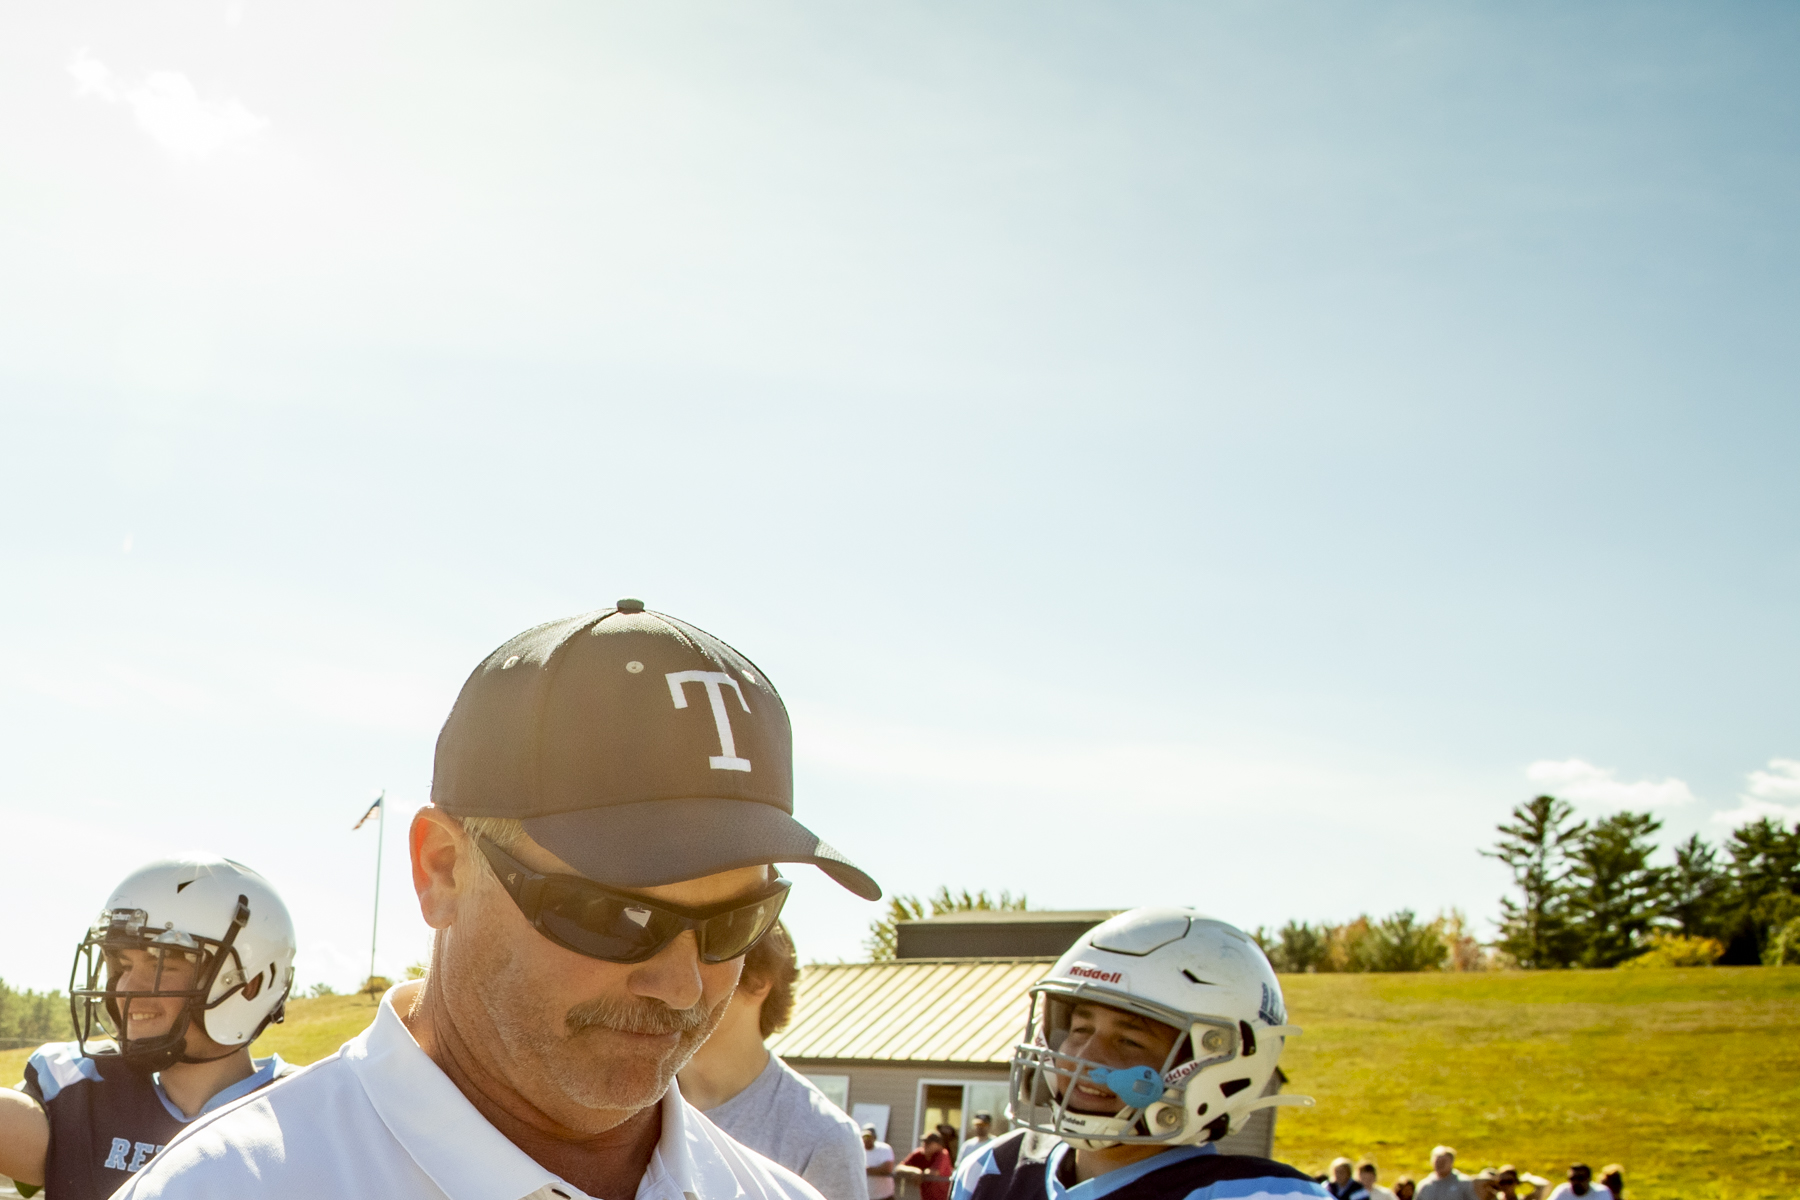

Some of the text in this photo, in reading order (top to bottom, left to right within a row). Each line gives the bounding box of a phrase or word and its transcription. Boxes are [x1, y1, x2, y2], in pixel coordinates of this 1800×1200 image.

[665, 670, 752, 772] T
[1069, 966, 1122, 984] Riddell
[1165, 1062, 1198, 1083] ddell
[104, 1137, 167, 1172] RE
